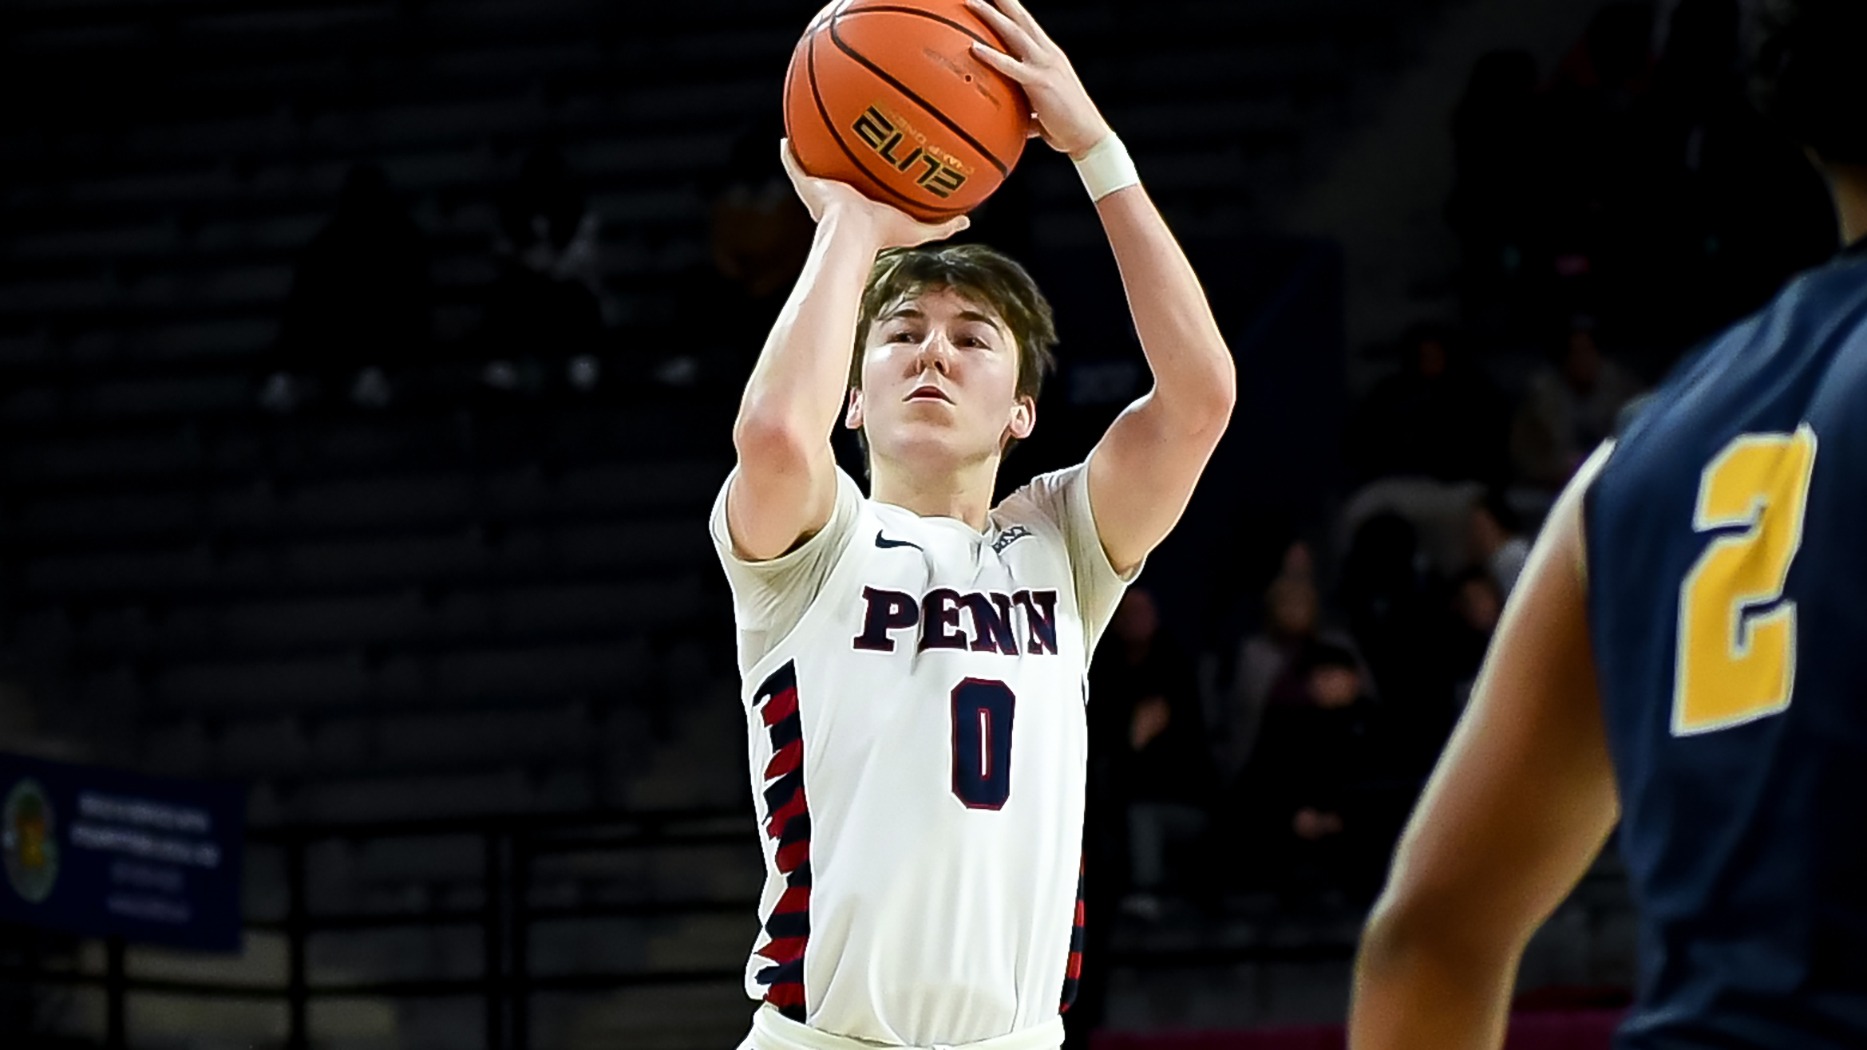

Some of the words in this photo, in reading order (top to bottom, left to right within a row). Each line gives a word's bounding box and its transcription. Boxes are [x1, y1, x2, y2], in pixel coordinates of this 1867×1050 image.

[851, 104, 968, 200] ELITE
[852, 585, 1059, 656] PENN
[1670, 422, 1818, 737] 2
[950, 676, 1016, 811] 0
